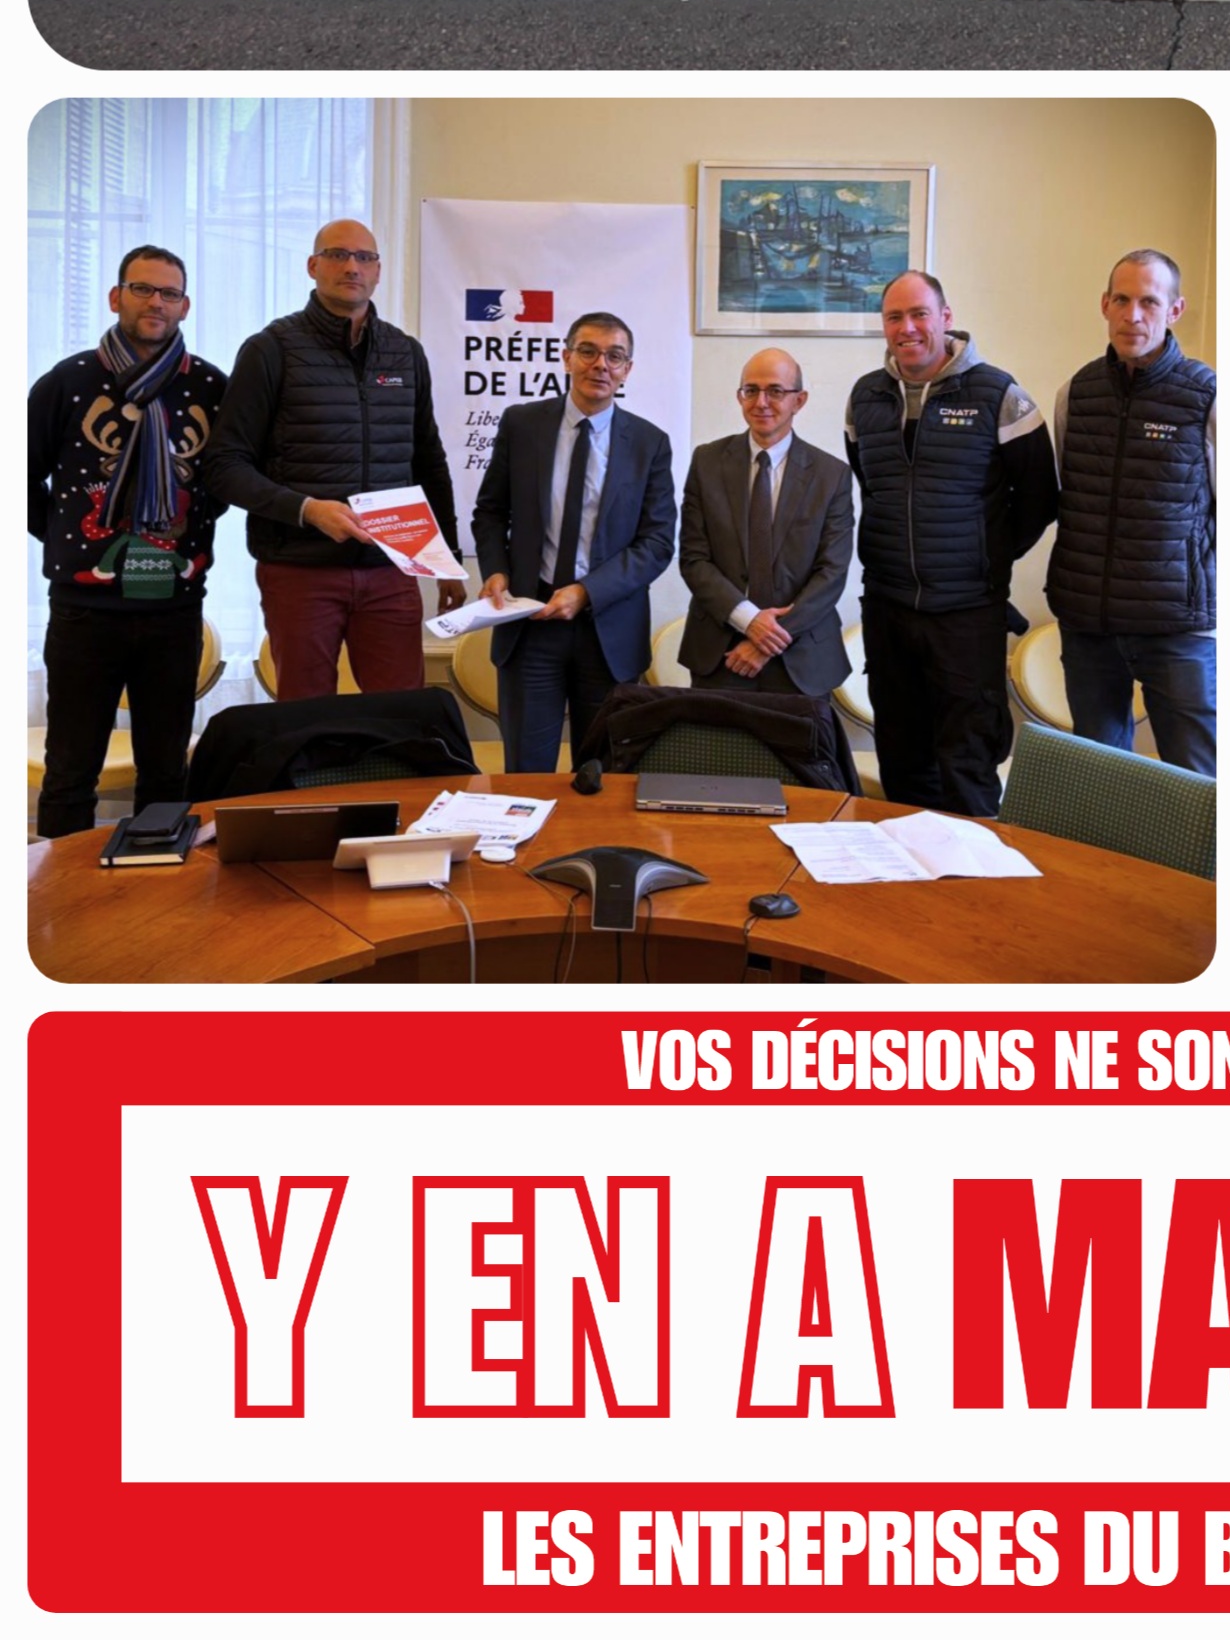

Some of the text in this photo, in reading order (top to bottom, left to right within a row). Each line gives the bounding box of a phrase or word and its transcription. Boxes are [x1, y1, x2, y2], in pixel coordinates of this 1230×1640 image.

[464, 330, 568, 363] PRÉFE
[464, 371, 626, 398] DE L'A
[465, 410, 500, 427] Libe
[939, 407, 979, 417] CNATP
[1143, 422, 1178, 433] CNATP
